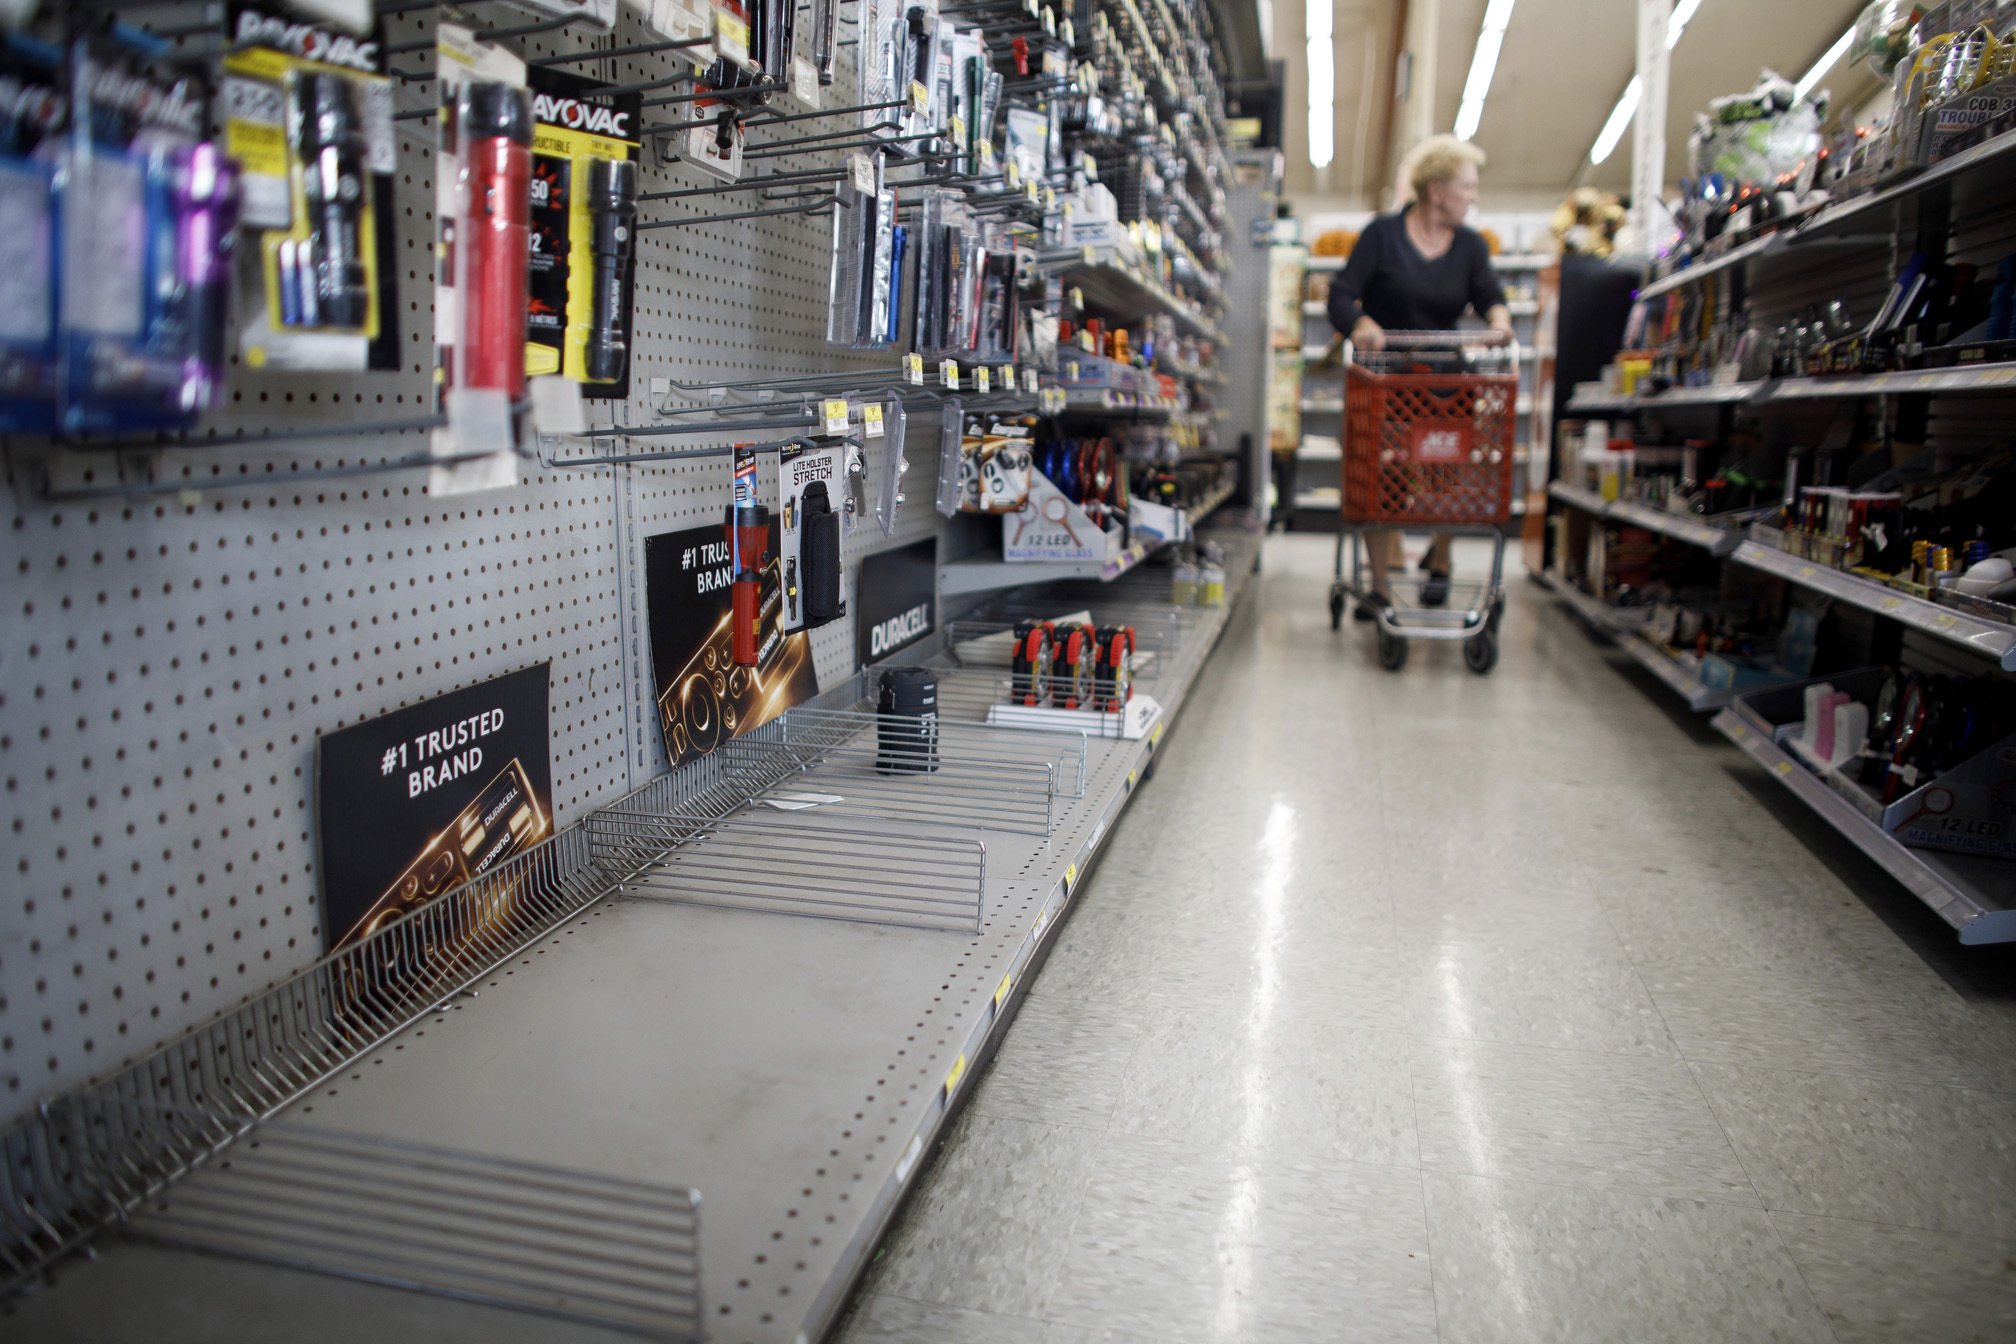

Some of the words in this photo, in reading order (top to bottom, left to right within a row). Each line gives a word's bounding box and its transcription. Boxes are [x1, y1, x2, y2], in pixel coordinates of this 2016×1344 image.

[533, 94, 630, 137] AYOVAC
[1969, 98, 1998, 112] COB
[793, 461, 805, 471] LITE
[807, 457, 832, 469] HOLSTER
[794, 467, 832, 485] STRETCH
[1028, 534, 1043, 545] 12
[1047, 534, 1070, 545] LED
[682, 547, 697, 570] #1
[700, 541, 730, 566] TRUS
[697, 566, 735, 594] BRAN
[871, 603, 928, 656] DURACELL
[381, 742, 407, 776] #1
[415, 708, 504, 761] TRUSTED
[408, 747, 483, 798] BRAND
[484, 787, 519, 827] DURACELL
[1907, 830, 1986, 849] MAGNIFYING
[1941, 818, 1962, 831] 12
[1967, 820, 2000, 836] LED
[475, 832, 511, 874] DURACELL
